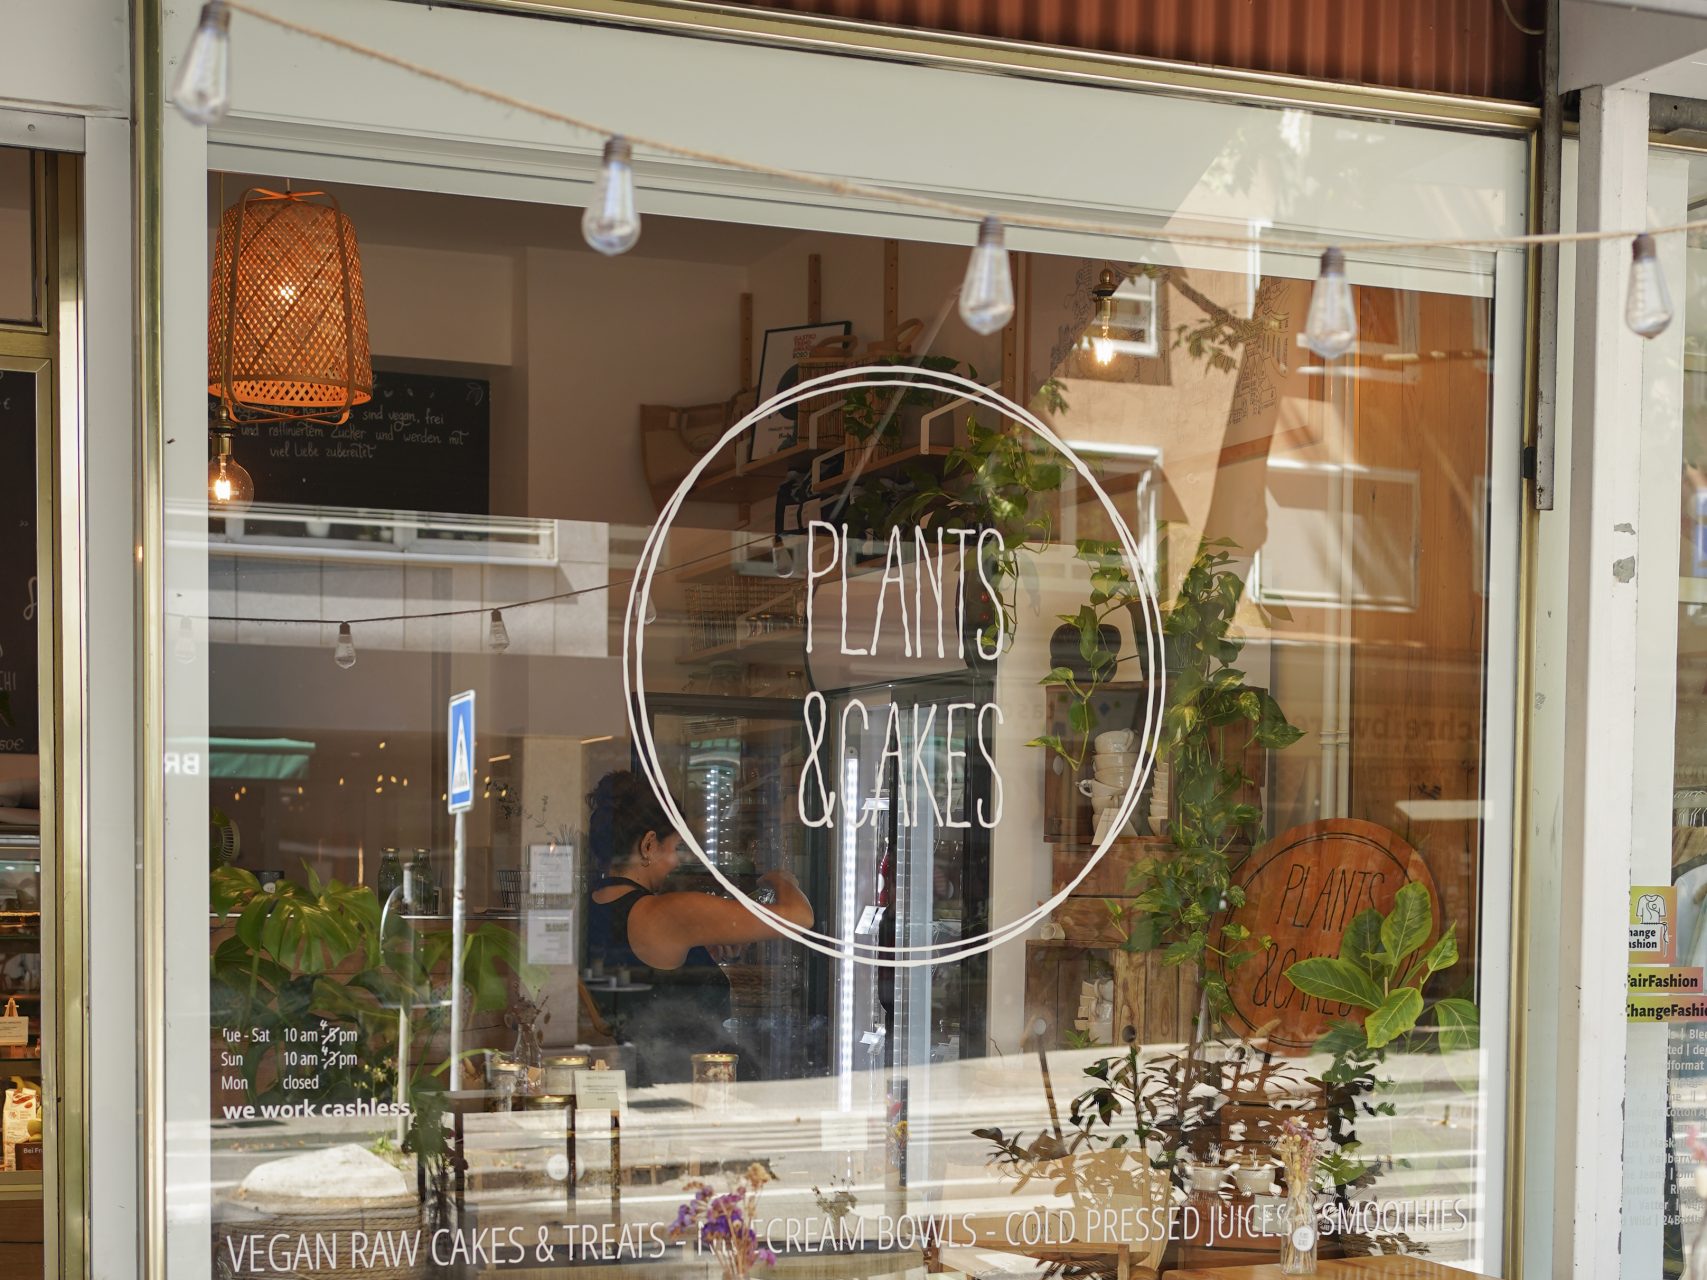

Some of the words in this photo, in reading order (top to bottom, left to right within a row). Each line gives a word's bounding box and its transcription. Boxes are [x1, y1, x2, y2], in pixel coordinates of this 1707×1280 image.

[362, 408, 383, 420] sind
[425, 408, 444, 425] frei
[330, 424, 367, 440] Zucker
[375, 427, 394, 441] und
[403, 429, 441, 444] werden
[449, 430, 469, 446] mit
[270, 443, 290, 457] viel
[806, 520, 1004, 660] PLANTS
[1629, 929, 1656, 939] hange
[252, 1028, 270, 1042] Sat
[284, 1028, 297, 1042] 10
[300, 1031, 318, 1042] am
[339, 1031, 358, 1046] pm
[221, 1052, 243, 1066] Sun
[284, 1051, 297, 1066] 10
[300, 1054, 318, 1066] am
[339, 1054, 358, 1069] pm
[221, 1076, 248, 1090] Mon
[283, 1075, 319, 1090] closed
[222, 1105, 255, 1120] we
[261, 1098, 316, 1119] work
[321, 1098, 410, 1117] cashless
[226, 1232, 338, 1273] VEGAN
[351, 1230, 421, 1269] RAW
[431, 1226, 525, 1267] CAKES
[536, 1224, 555, 1263] &
[563, 1221, 666, 1261] TREATS
[879, 1211, 977, 1252] BOWLS
[1006, 1210, 1076, 1246] COLD
[1087, 1205, 1200, 1243] PRESSED
[1321, 1198, 1467, 1236] SMOOTHIES
